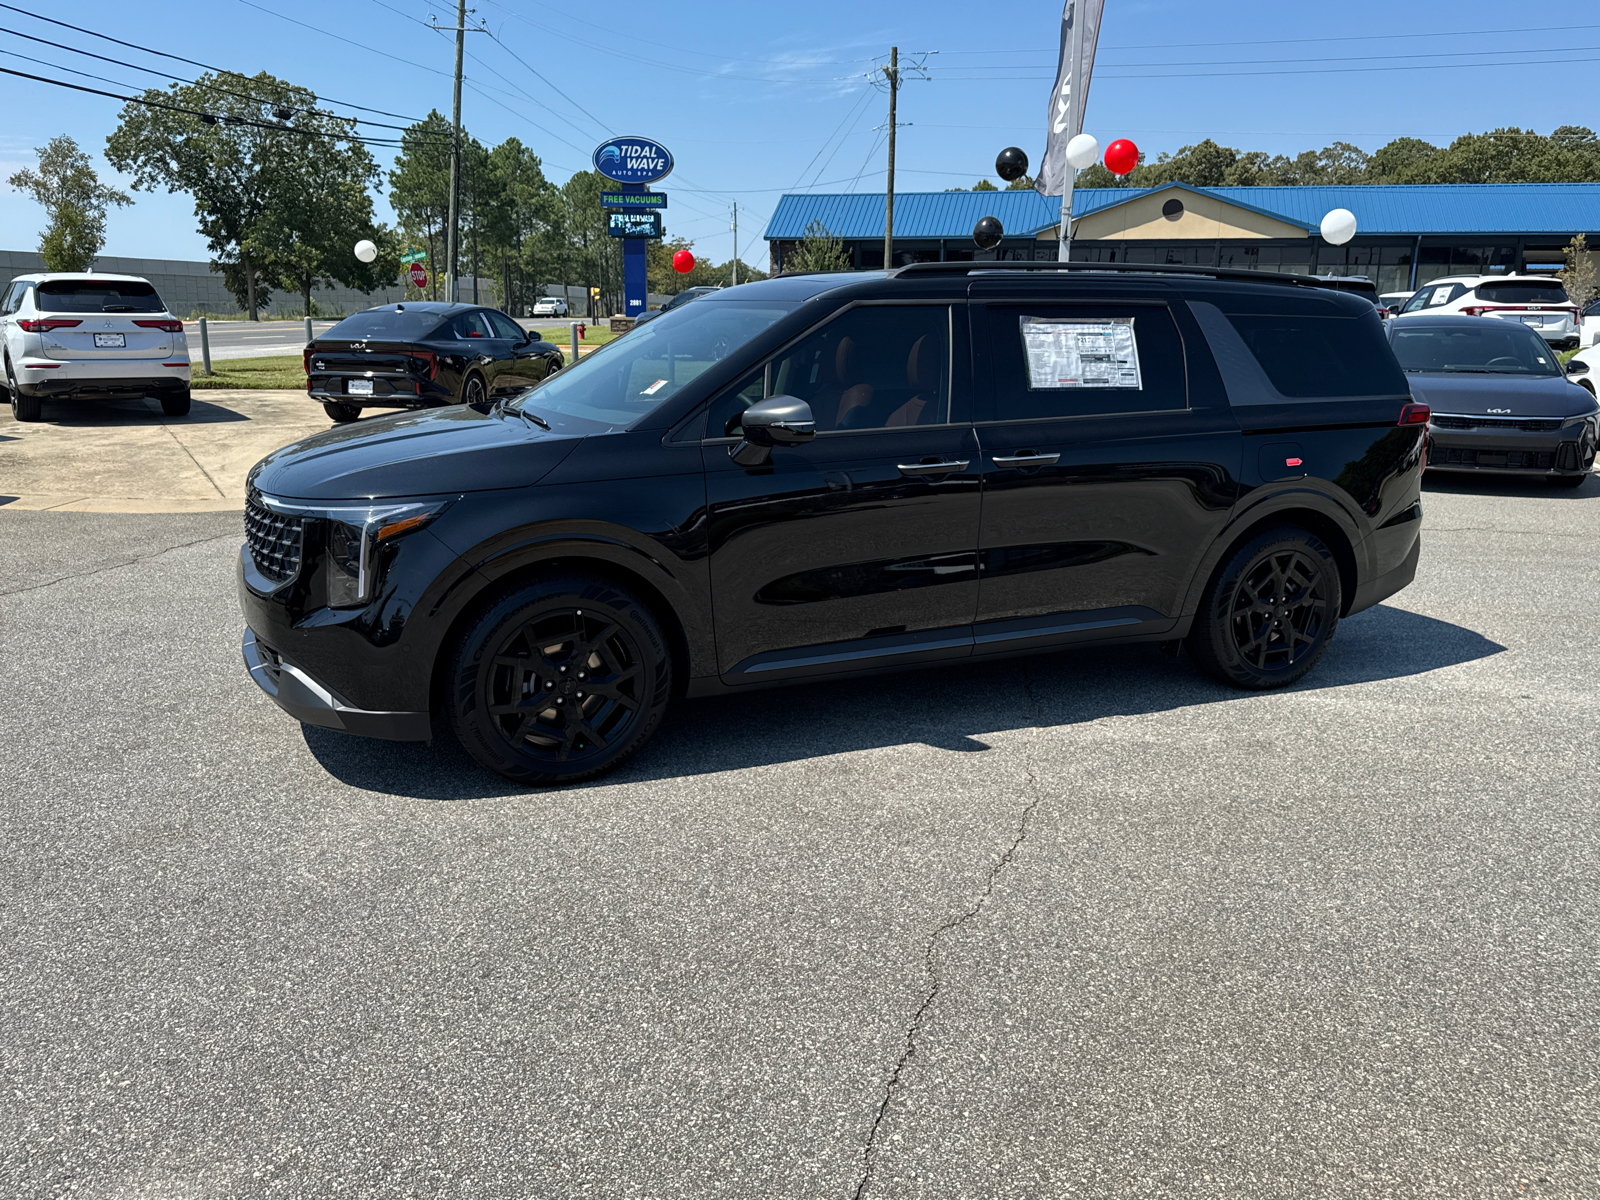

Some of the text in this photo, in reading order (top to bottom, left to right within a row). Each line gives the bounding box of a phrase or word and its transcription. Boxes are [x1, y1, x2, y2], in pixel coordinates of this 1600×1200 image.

[621, 146, 657, 158] TIDAL
[626, 158, 665, 170] WAVE
[603, 195, 662, 204] FREE VACUUMS
[411, 270, 425, 280] STOP
